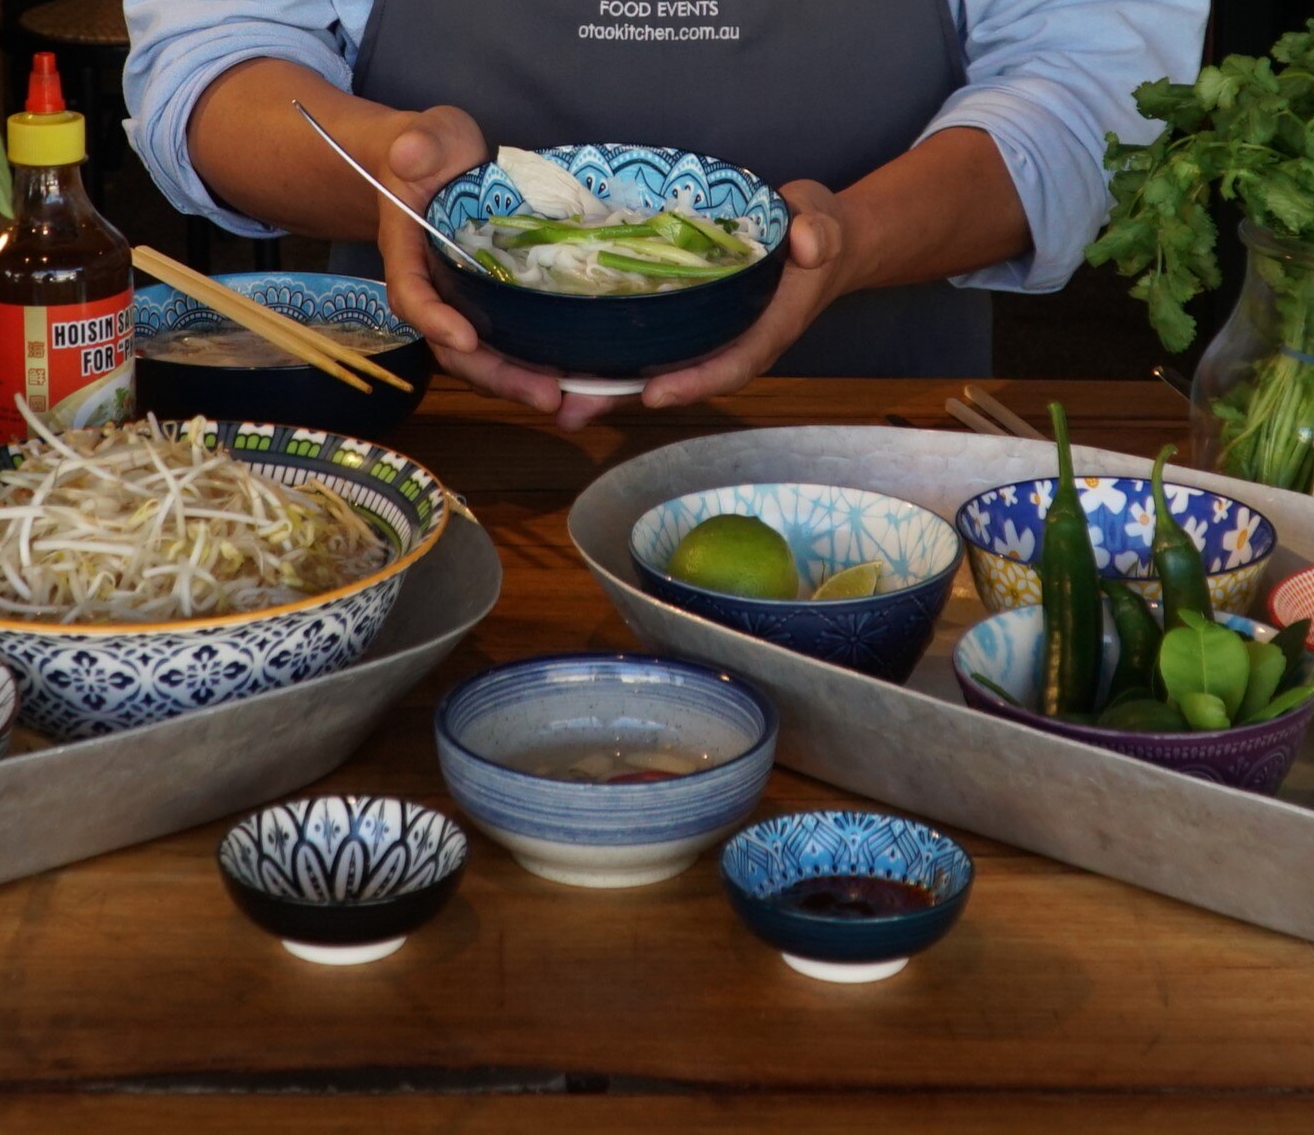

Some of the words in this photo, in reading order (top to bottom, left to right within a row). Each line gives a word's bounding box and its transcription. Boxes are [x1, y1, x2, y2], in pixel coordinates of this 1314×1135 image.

[600, 1, 651, 17] FOOD
[658, 1, 719, 17] EVENTS
[579, 23, 740, 41] otaokitchen.com.au
[52, 314, 115, 349] HOISIN
[81, 344, 115, 377] FOR
